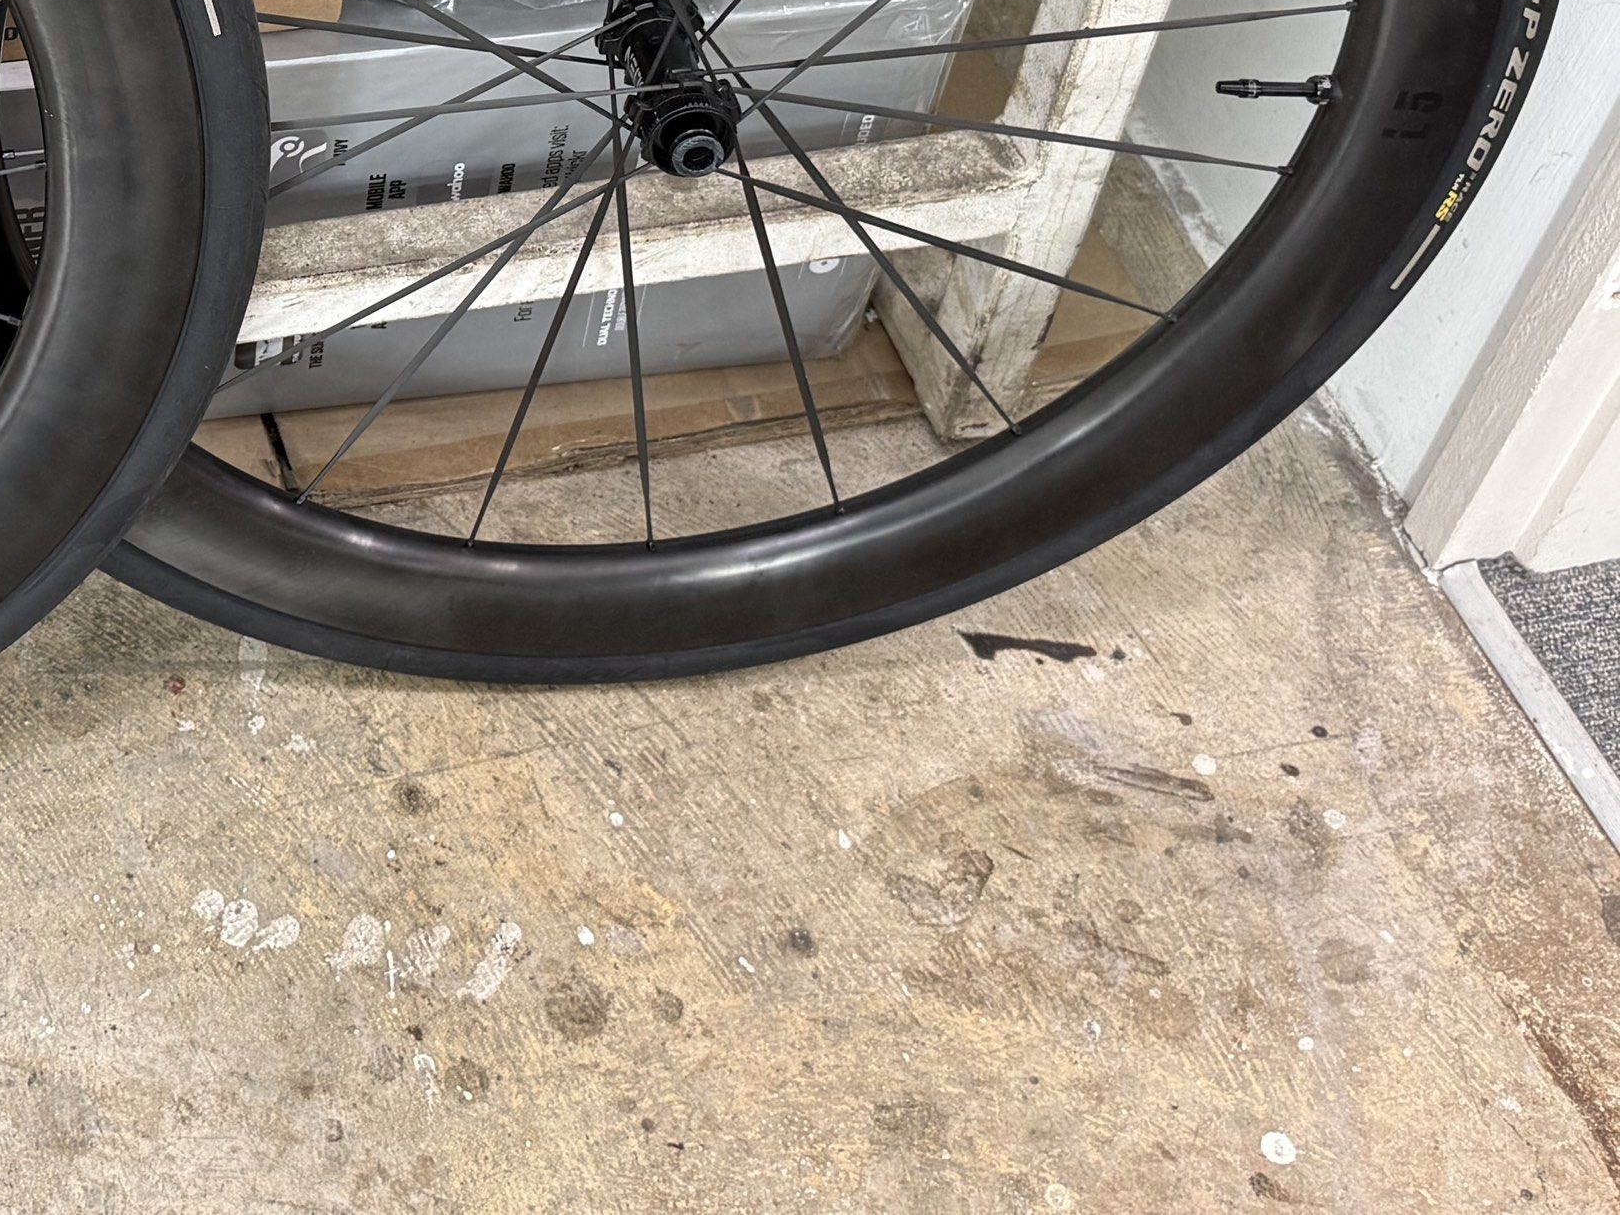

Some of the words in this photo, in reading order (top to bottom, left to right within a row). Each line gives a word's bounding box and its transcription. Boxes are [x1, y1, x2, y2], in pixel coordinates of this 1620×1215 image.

[1524, 7, 1541, 39] P
[1466, 46, 1530, 172] ZERO
[365, 173, 387, 211] MOBILE
[388, 179, 407, 200] APP
[447, 162, 466, 201] wahoo
[597, 323, 611, 346] DUAL
[309, 354, 323, 369] THE
